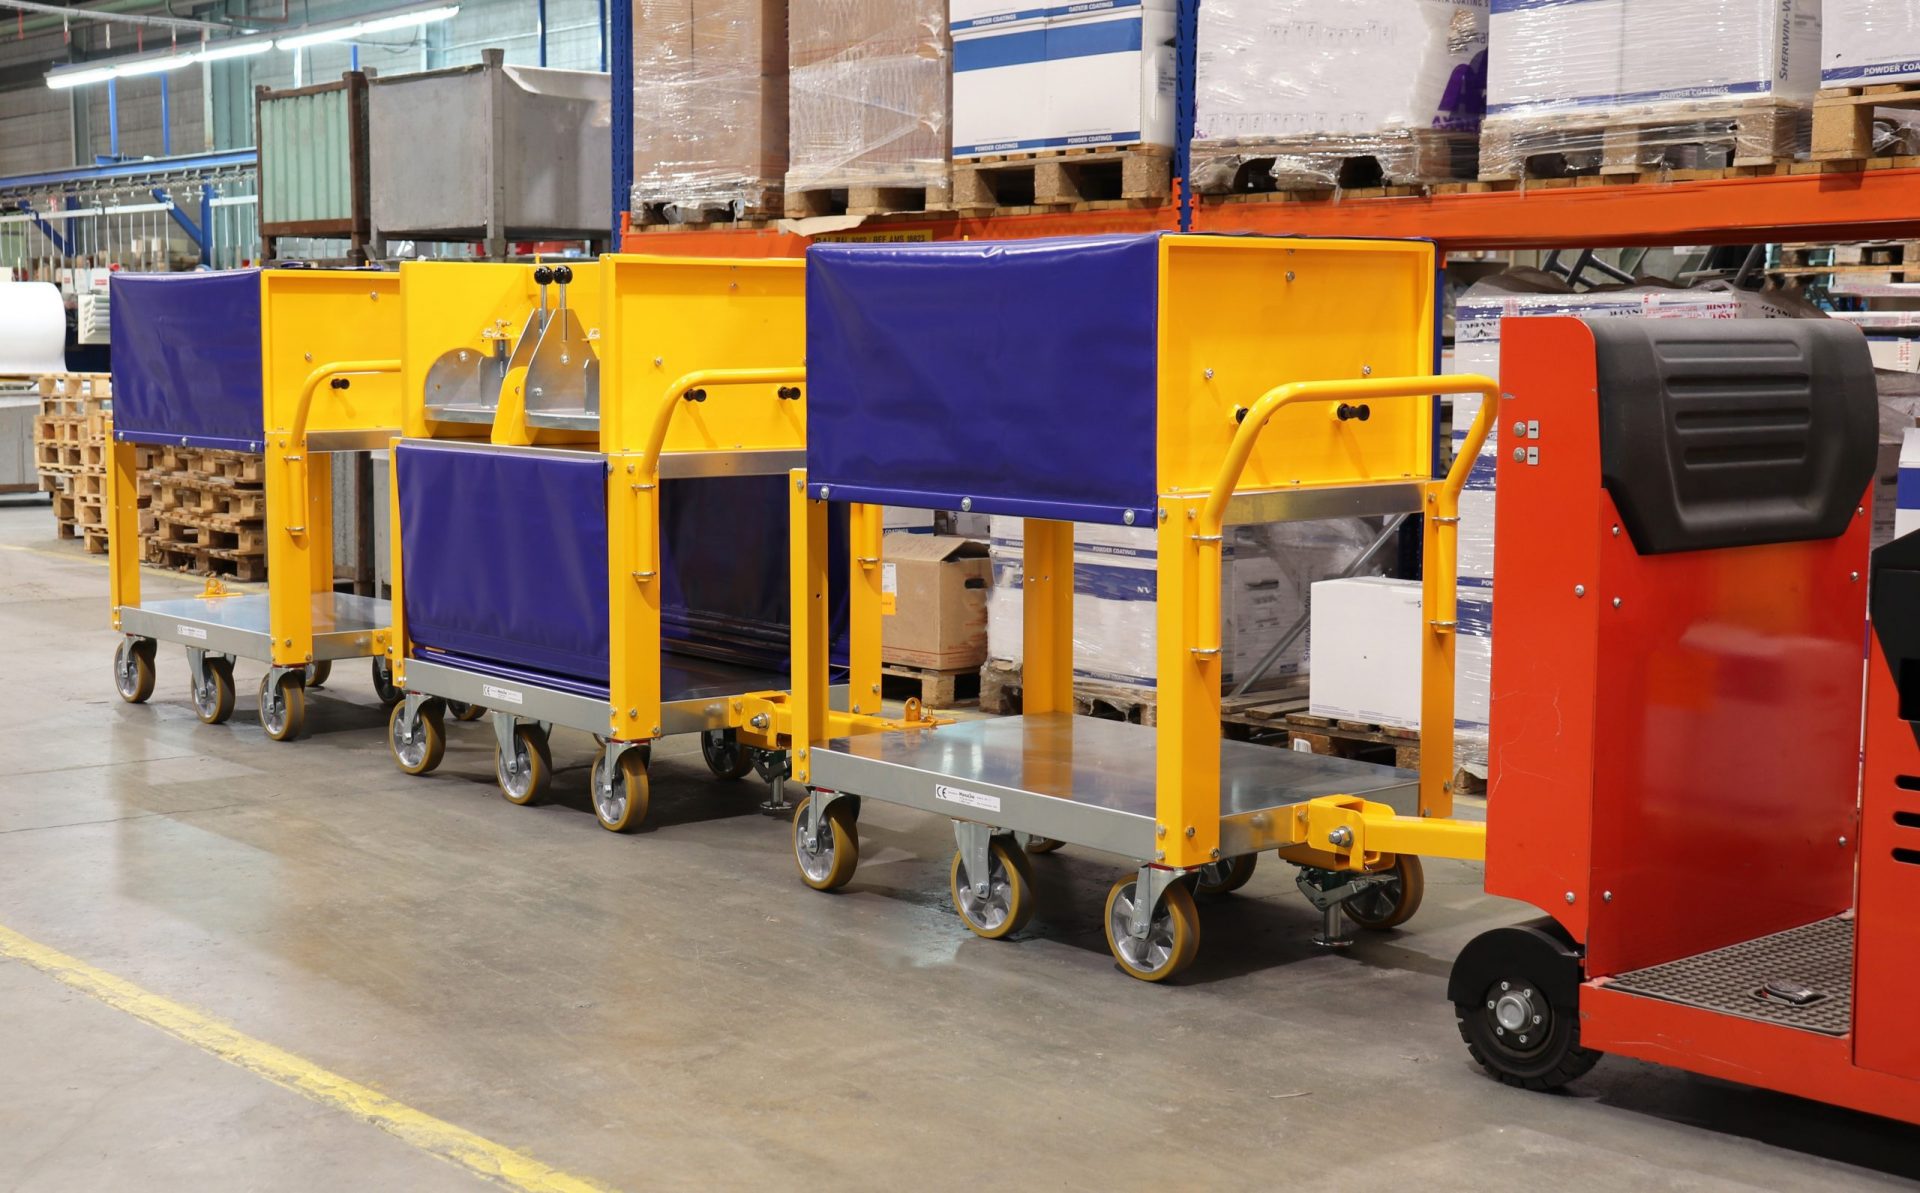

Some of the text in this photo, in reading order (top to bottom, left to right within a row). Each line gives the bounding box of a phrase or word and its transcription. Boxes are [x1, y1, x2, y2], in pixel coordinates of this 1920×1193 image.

[993, 14, 1017, 23] COATINGS
[1780, 0, 1791, 80] SHERWIN-W
[1864, 62, 1920, 75] POWDER COA
[1067, 134, 1113, 144] POWDER COATINGS
[975, 142, 1018, 152] POWDER COATINGS
[1092, 546, 1136, 556] POWDER COATINGS
